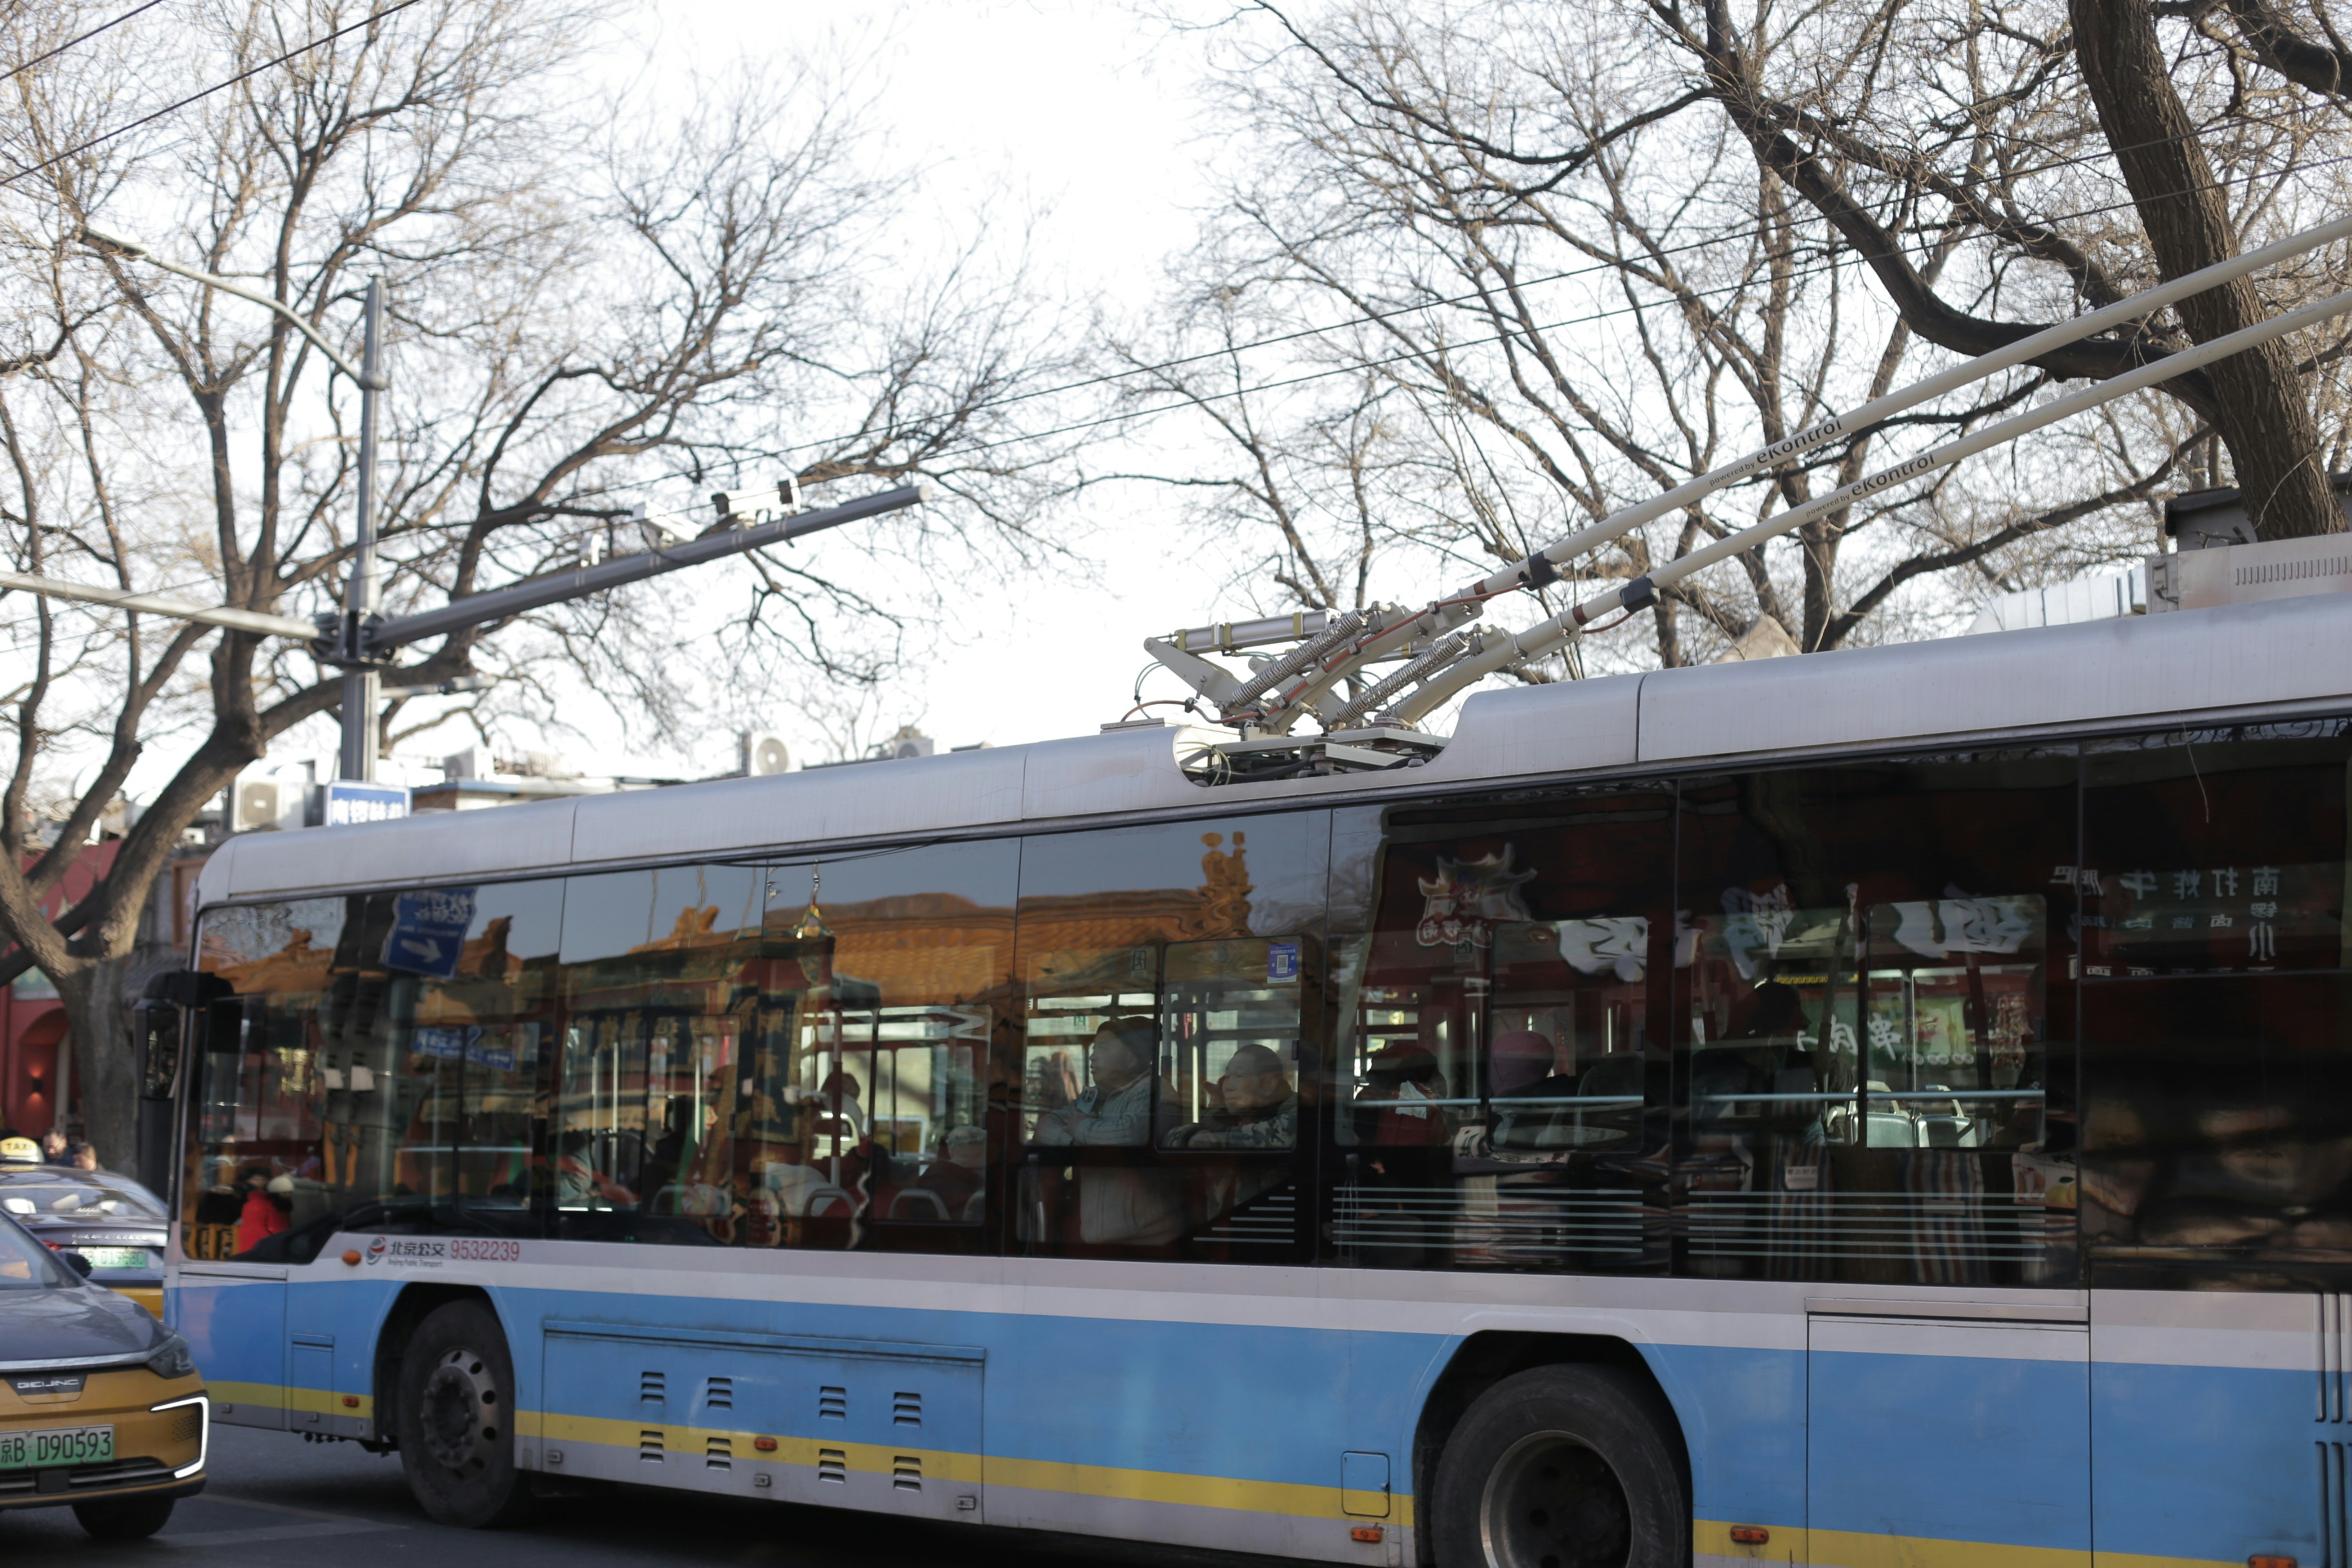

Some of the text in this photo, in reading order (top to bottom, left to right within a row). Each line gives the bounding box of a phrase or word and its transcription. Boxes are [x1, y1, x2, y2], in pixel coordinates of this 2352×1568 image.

[1709, 466, 1744, 487] powered
[1744, 461, 1756, 473] by
[1805, 497, 1839, 518] powered
[1840, 494, 1850, 504] by
[389, 1239, 520, 1261] 北京公交 9532239
[387, 1258, 443, 1268] Beijing Public Transport
[17, 1378, 79, 1389] BEIJING
[1, 1431, 112, 1463] 京B D90593
